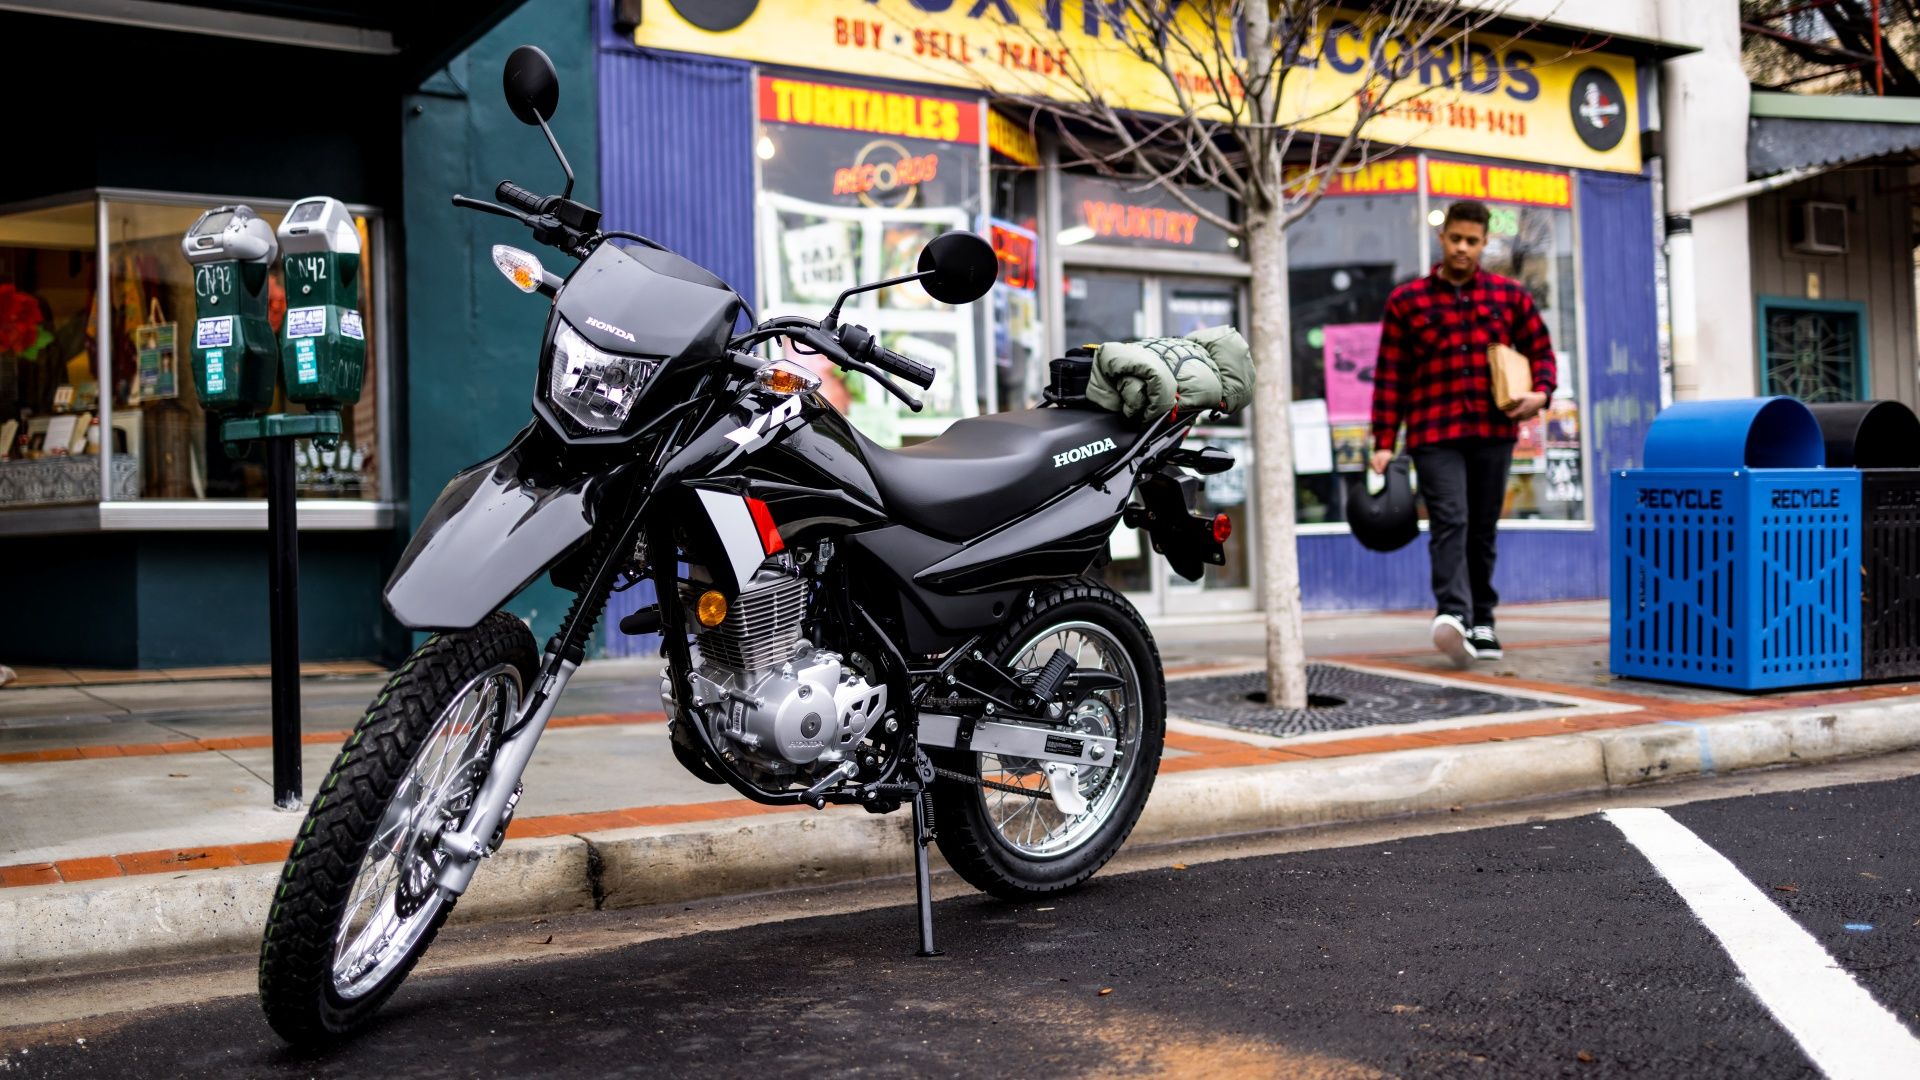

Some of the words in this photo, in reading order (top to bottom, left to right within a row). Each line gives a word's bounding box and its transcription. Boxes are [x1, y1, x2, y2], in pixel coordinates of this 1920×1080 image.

[835, 17, 883, 49] BUY
[914, 28, 974, 64] SELL
[998, 40, 1069, 77] TRADE
[771, 79, 960, 142] TURNTABLES
[833, 153, 938, 196] RECORDS
[1427, 161, 1486, 199] VINYL
[1488, 167, 1569, 207] RECORDS
[1083, 199, 1199, 245] WUXTRY
[585, 316, 637, 344] HONDA
[1053, 437, 1118, 468] HONDA
[1638, 488, 1723, 509] RECYCLE
[1771, 488, 1840, 509] RECYCLE
